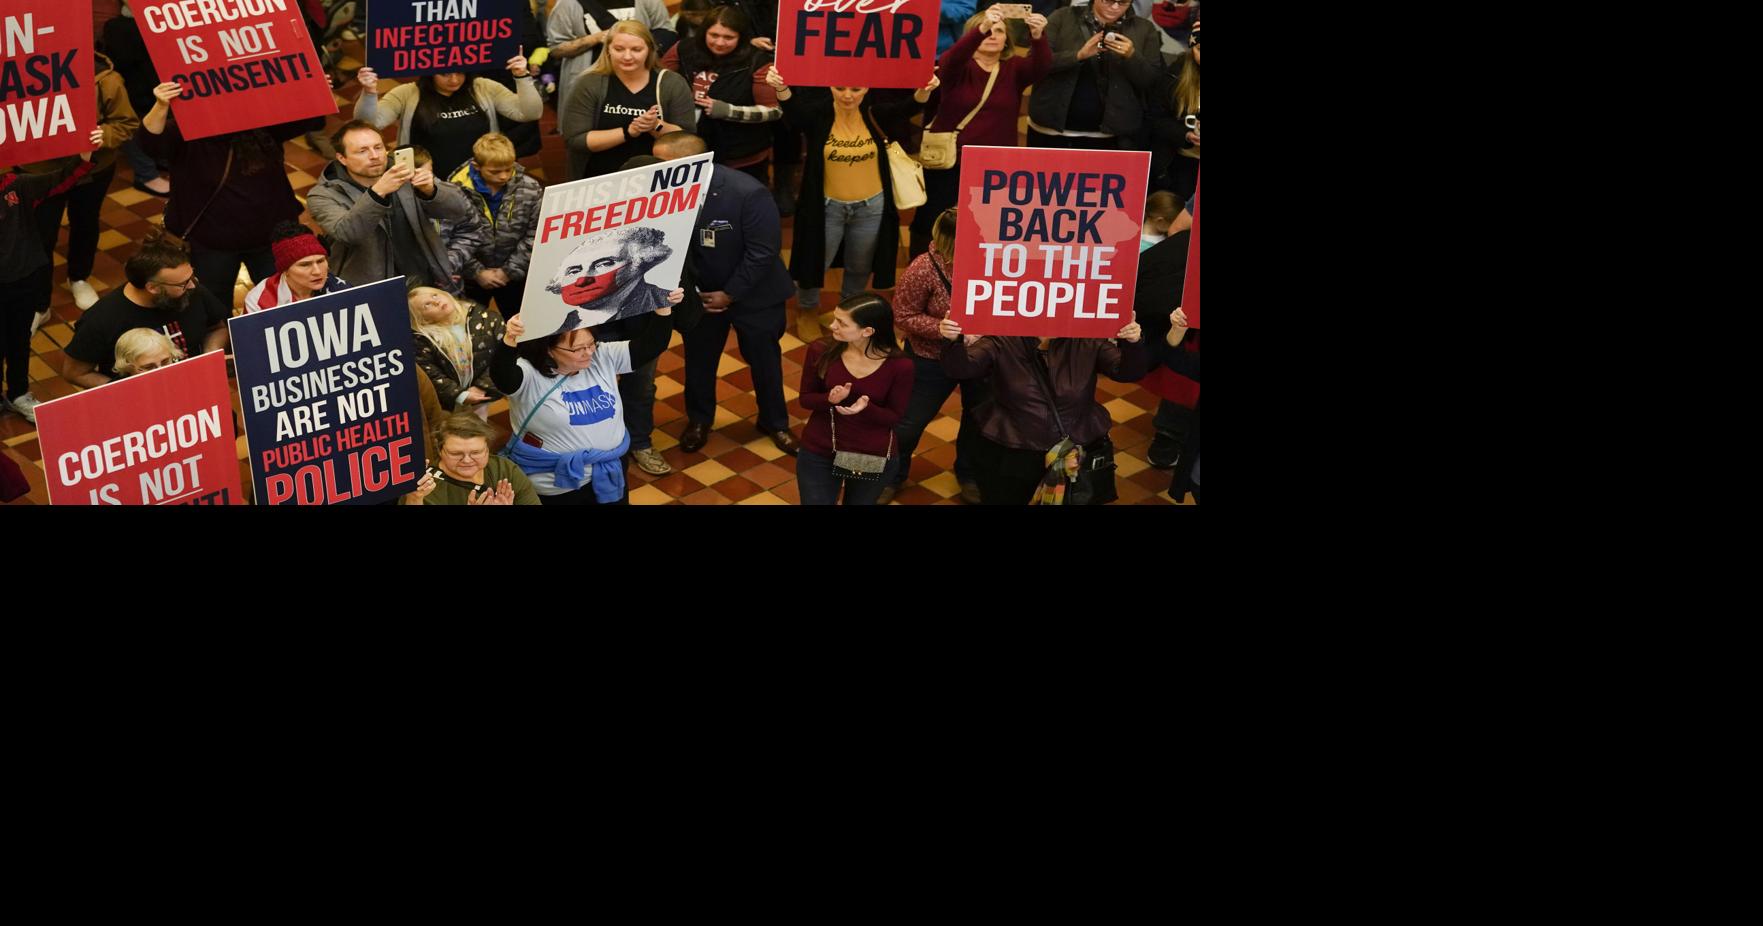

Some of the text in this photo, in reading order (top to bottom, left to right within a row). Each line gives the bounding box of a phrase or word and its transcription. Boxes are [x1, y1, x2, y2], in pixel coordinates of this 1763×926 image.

[0, 12, 55, 58] N-
[375, 18, 512, 49] INFECTIOUS
[411, 0, 478, 23] THAN
[794, 10, 923, 59] FEAR
[177, 22, 279, 65] IS NOT
[393, 43, 493, 72] DISEASE
[0, 48, 80, 102] ASK
[171, 52, 313, 101] CONSENT!
[547, 158, 709, 214] THIS IS NOT
[981, 169, 1127, 209] POWER
[540, 183, 702, 244] FREEDOM
[998, 207, 1107, 245] BACK
[978, 243, 1115, 280] TO THE
[964, 279, 1123, 320] PEOPLE
[264, 302, 382, 374] IOWA
[251, 348, 405, 413] BUSINESSES
[275, 383, 390, 442] ARE NOT
[57, 404, 223, 487] COERCION
[262, 411, 410, 473] PUBLIC HEALTH
[138, 452, 204, 505] NOT
[265, 437, 415, 505] POLICE
